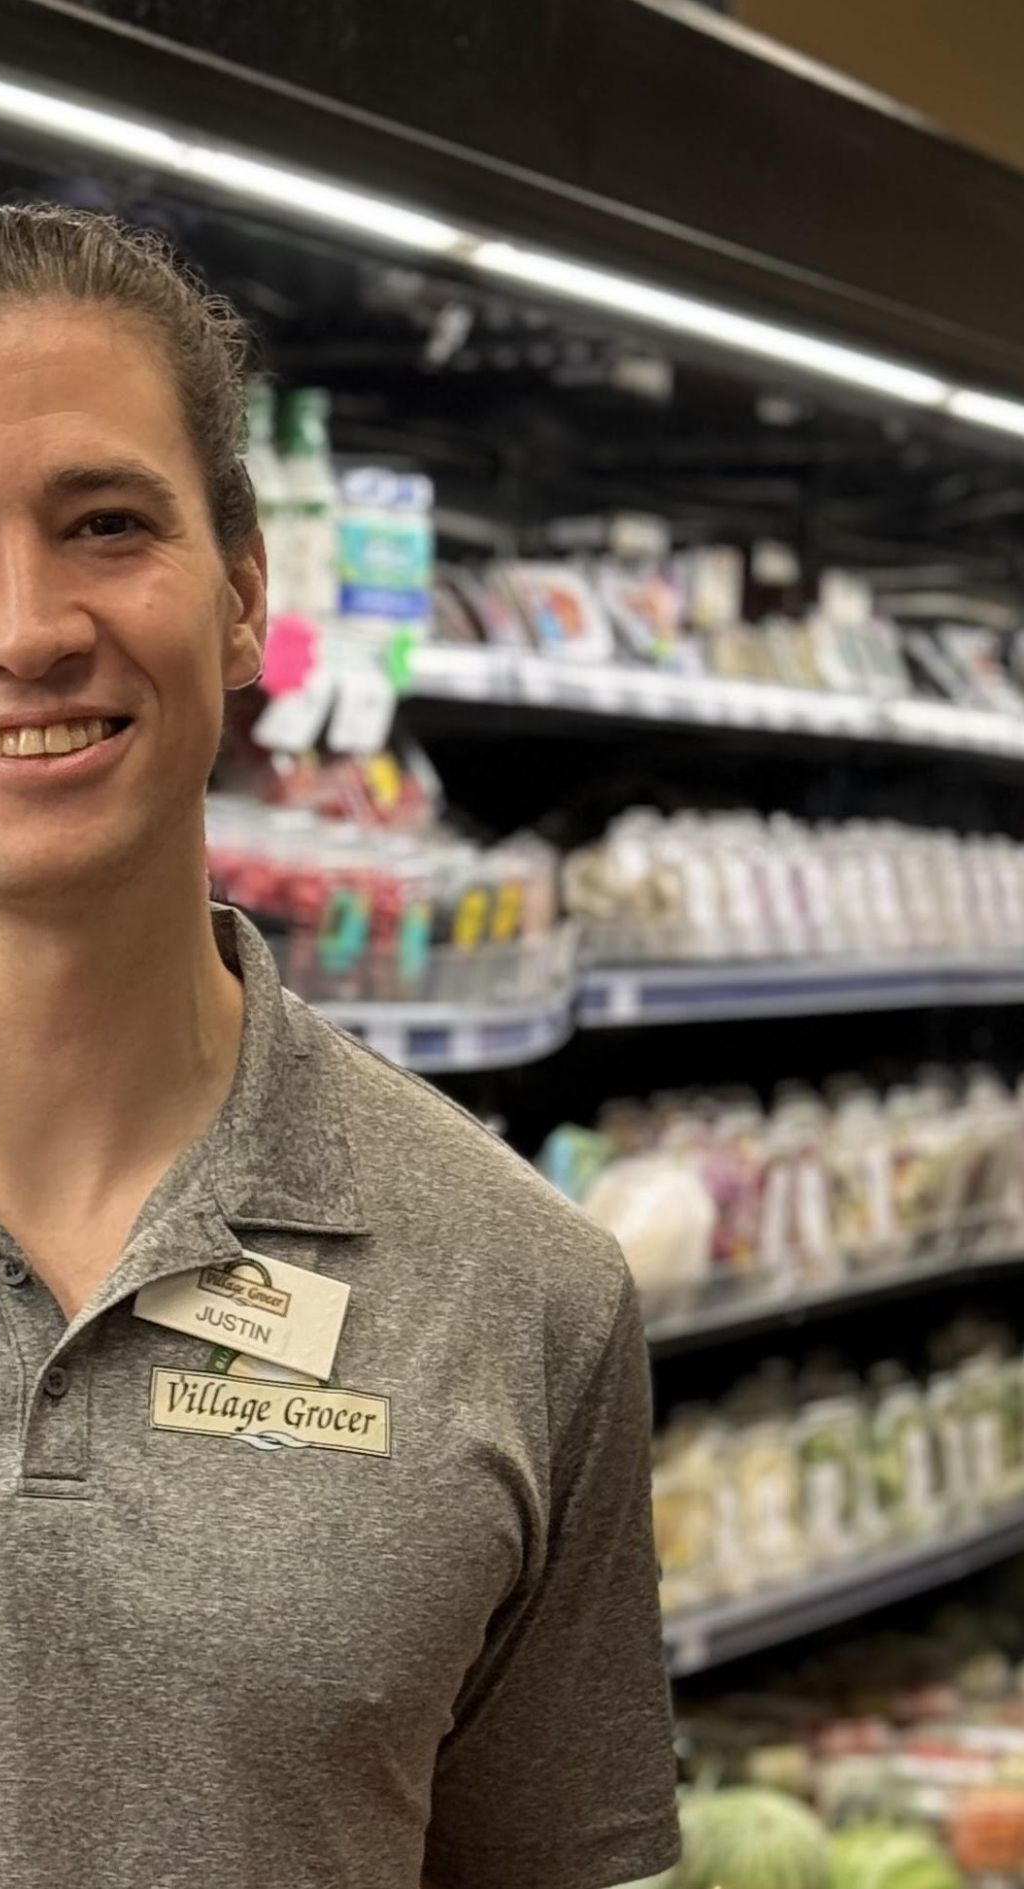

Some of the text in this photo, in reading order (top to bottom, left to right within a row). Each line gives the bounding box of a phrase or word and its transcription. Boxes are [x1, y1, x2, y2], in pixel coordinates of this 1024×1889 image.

[205, 1270, 284, 1307] Village Grocer
[195, 1306, 272, 1345] JUSTIN
[166, 1374, 377, 1436] Village Grocer
